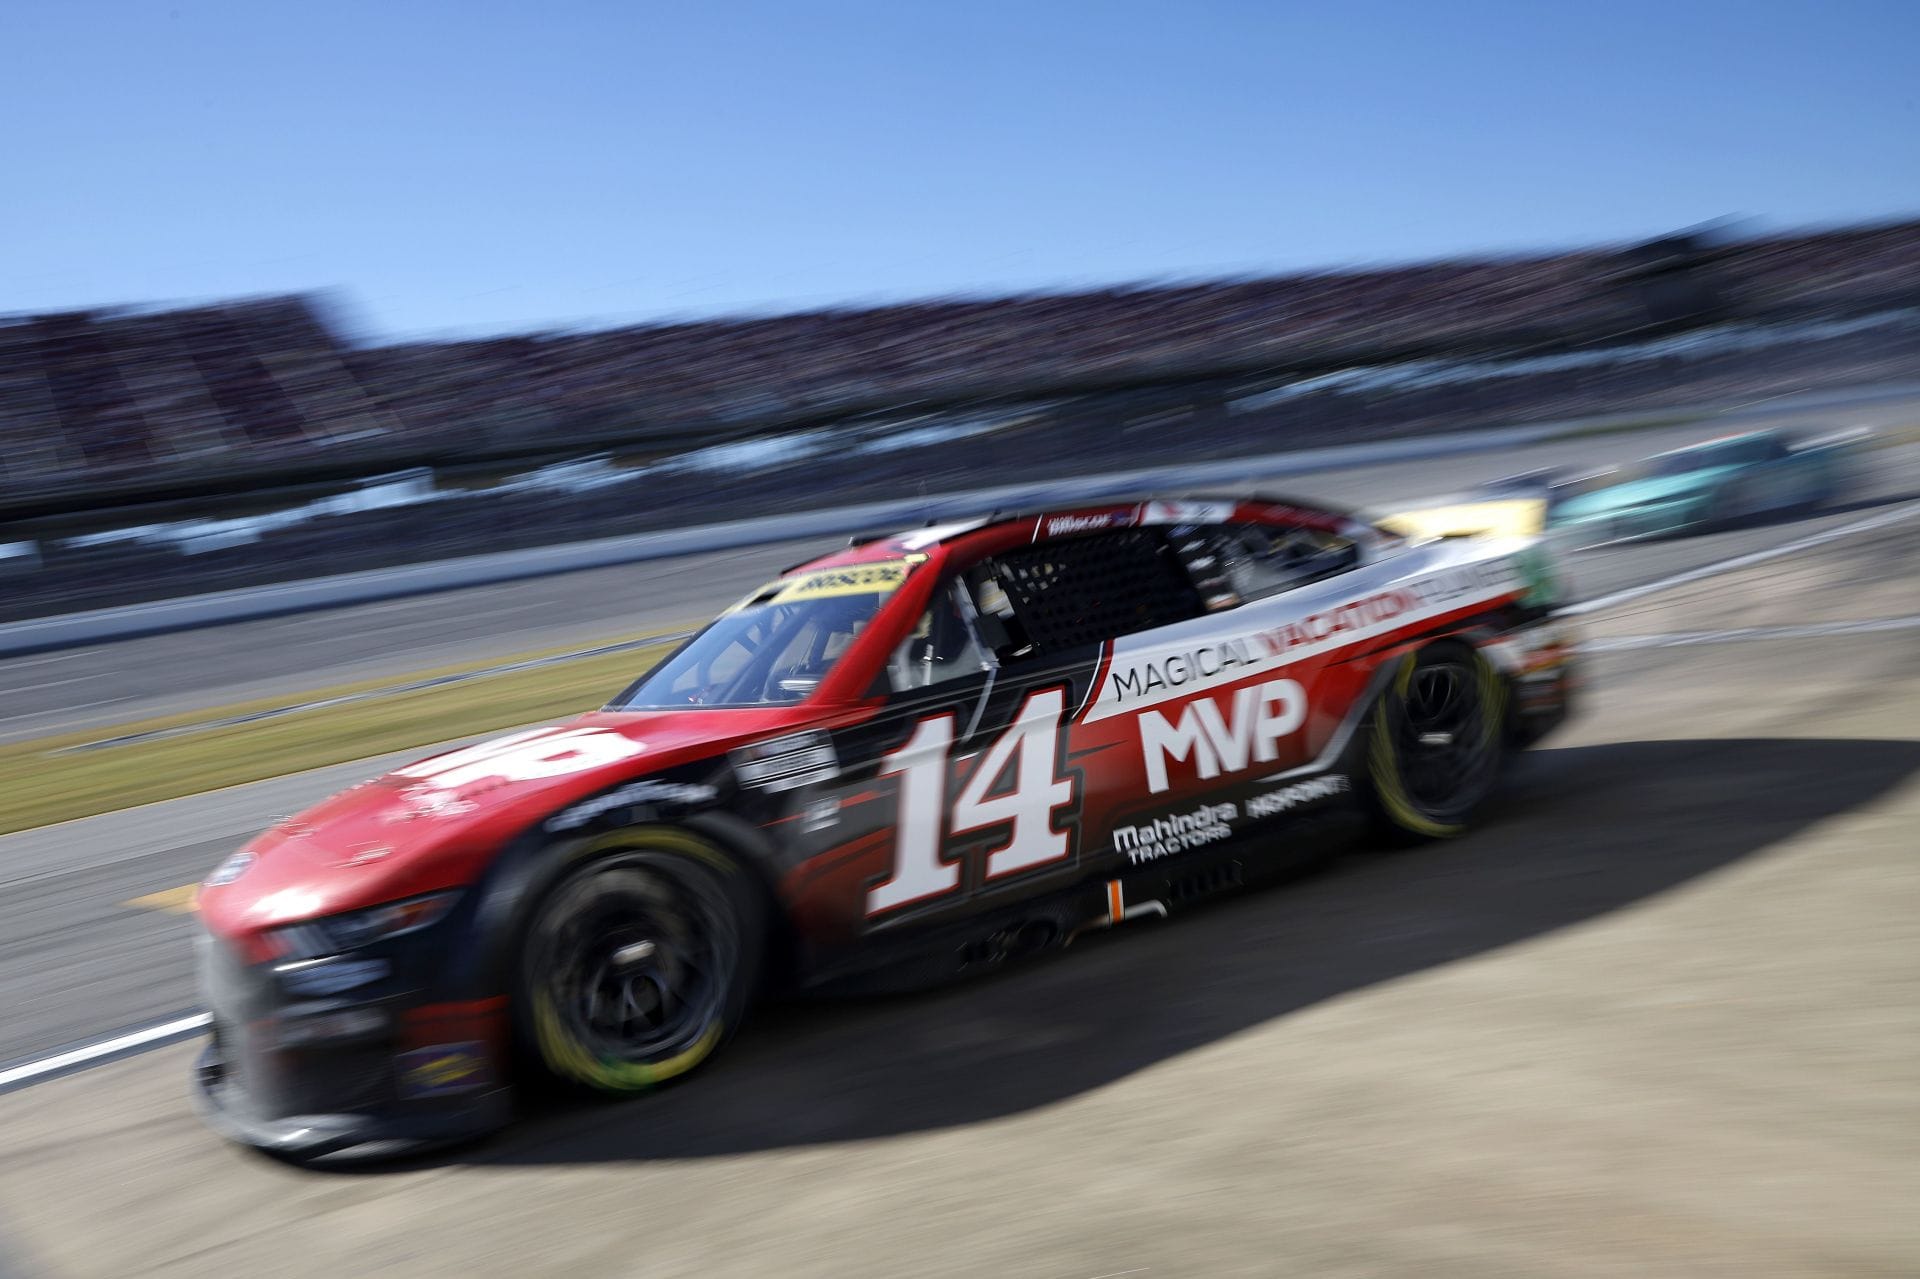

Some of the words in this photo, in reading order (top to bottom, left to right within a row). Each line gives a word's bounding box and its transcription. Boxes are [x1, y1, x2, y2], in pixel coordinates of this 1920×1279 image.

[1111, 636, 1261, 702] MAGICAL
[1137, 678, 1309, 795] MVP
[865, 685, 1074, 918] 14
[1112, 802, 1239, 853] Mahindra
